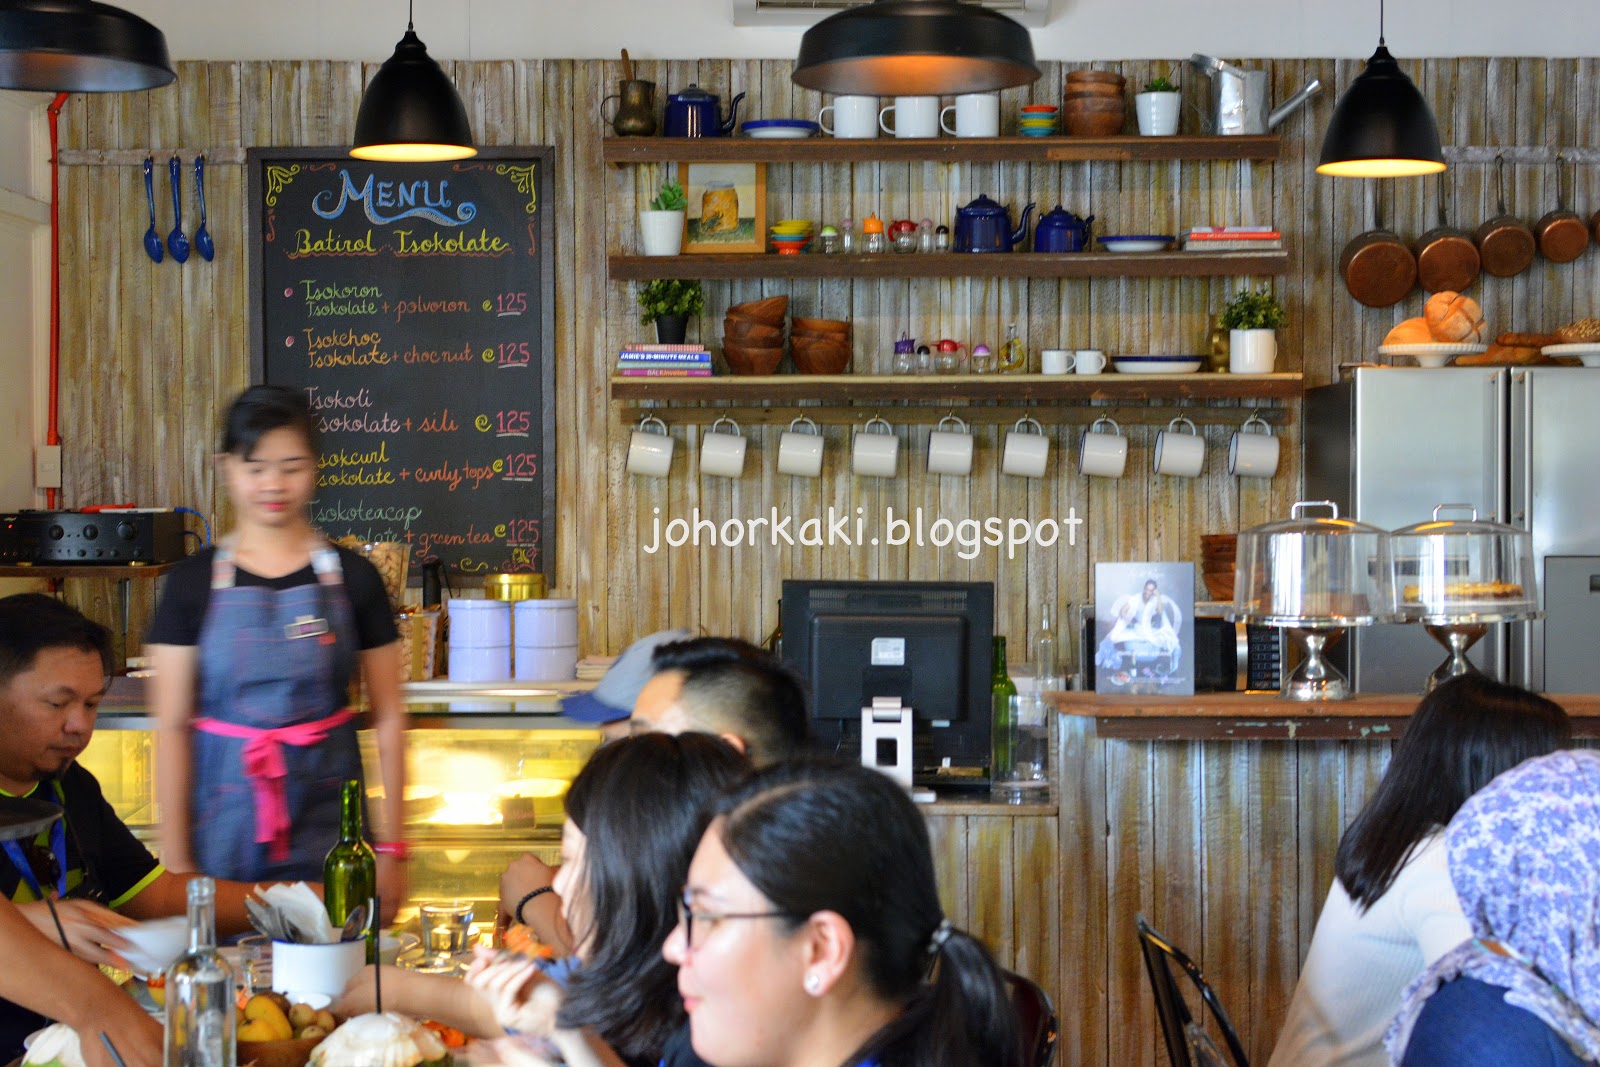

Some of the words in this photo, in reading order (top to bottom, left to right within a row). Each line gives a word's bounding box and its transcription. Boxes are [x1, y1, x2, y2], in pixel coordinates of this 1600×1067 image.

[294, 228, 376, 255] Batirol
[393, 229, 510, 254] Tsokolate
[300, 279, 382, 301] Tsokoron
[307, 300, 378, 318] Tsokolate
[393, 295, 470, 324] polvoron
[496, 293, 527, 313] 125
[303, 328, 381, 350] Tsokchoc
[309, 346, 391, 368] Tsokolate
[497, 342, 530, 364] 125
[304, 386, 373, 410] Tsokoli
[311, 411, 401, 433] sokolate
[417, 409, 459, 433] sili
[496, 410, 530, 433] 125
[315, 440, 390, 469] sokcurl
[314, 467, 396, 487] sokolate
[415, 460, 462, 491] curly
[463, 460, 494, 490] tops
[506, 453, 537, 476] 125
[416, 532, 465, 557] green
[506, 519, 539, 543] 125
